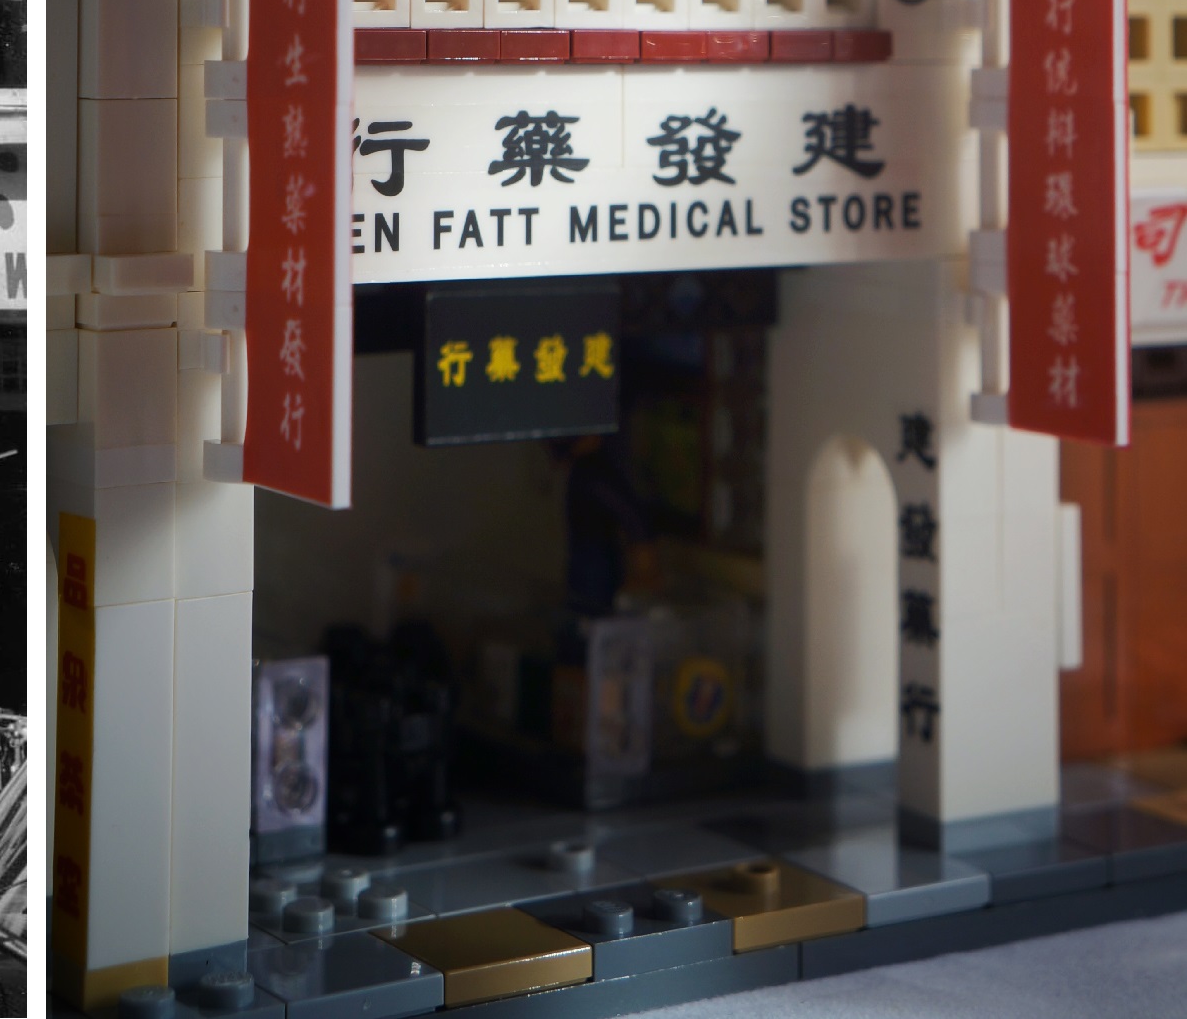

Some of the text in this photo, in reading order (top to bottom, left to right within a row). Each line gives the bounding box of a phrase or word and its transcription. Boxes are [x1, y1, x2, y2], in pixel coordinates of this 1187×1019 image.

[351, 191, 923, 254] EN FATT MEDICAL STORE
